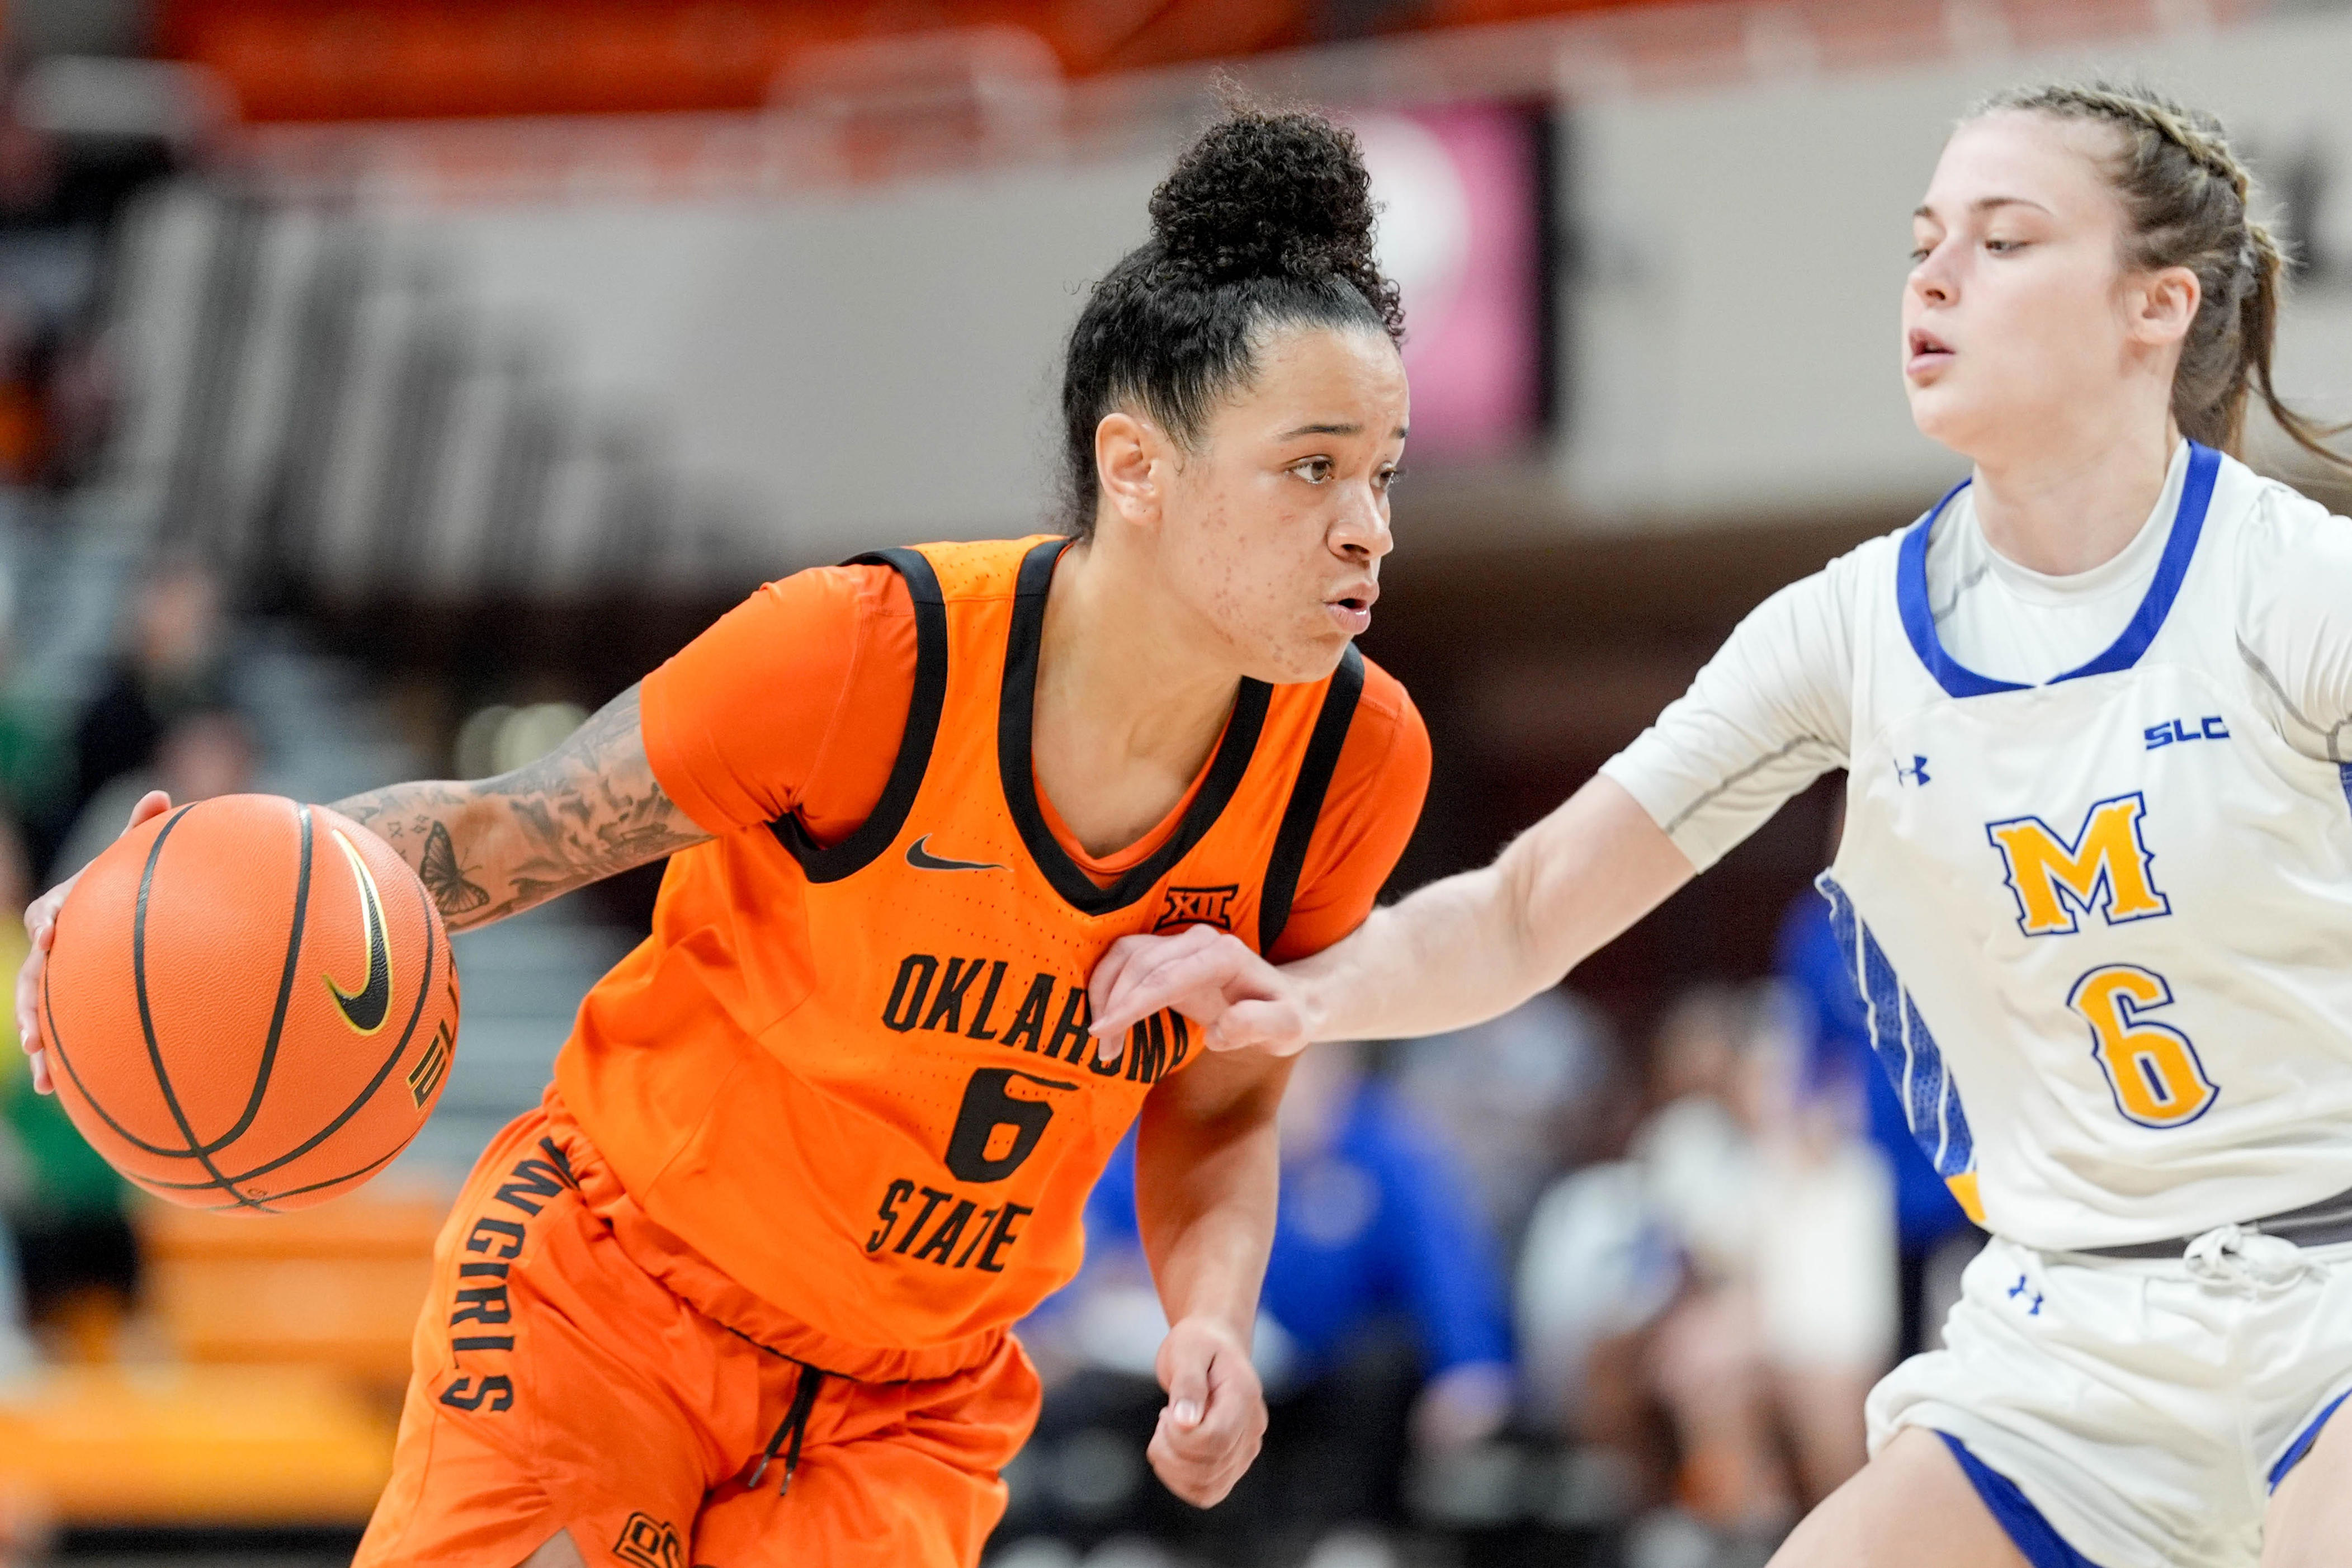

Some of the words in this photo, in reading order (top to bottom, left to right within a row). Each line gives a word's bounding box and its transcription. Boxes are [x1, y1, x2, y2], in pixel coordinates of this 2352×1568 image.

[2143, 716, 2230, 750] SLC
[1153, 883, 1239, 934] XII
[1985, 790, 2172, 937] M
[2066, 963, 2220, 1129] 6
[944, 1067, 1080, 1183] 6
[865, 1178, 1034, 1273] STATE
